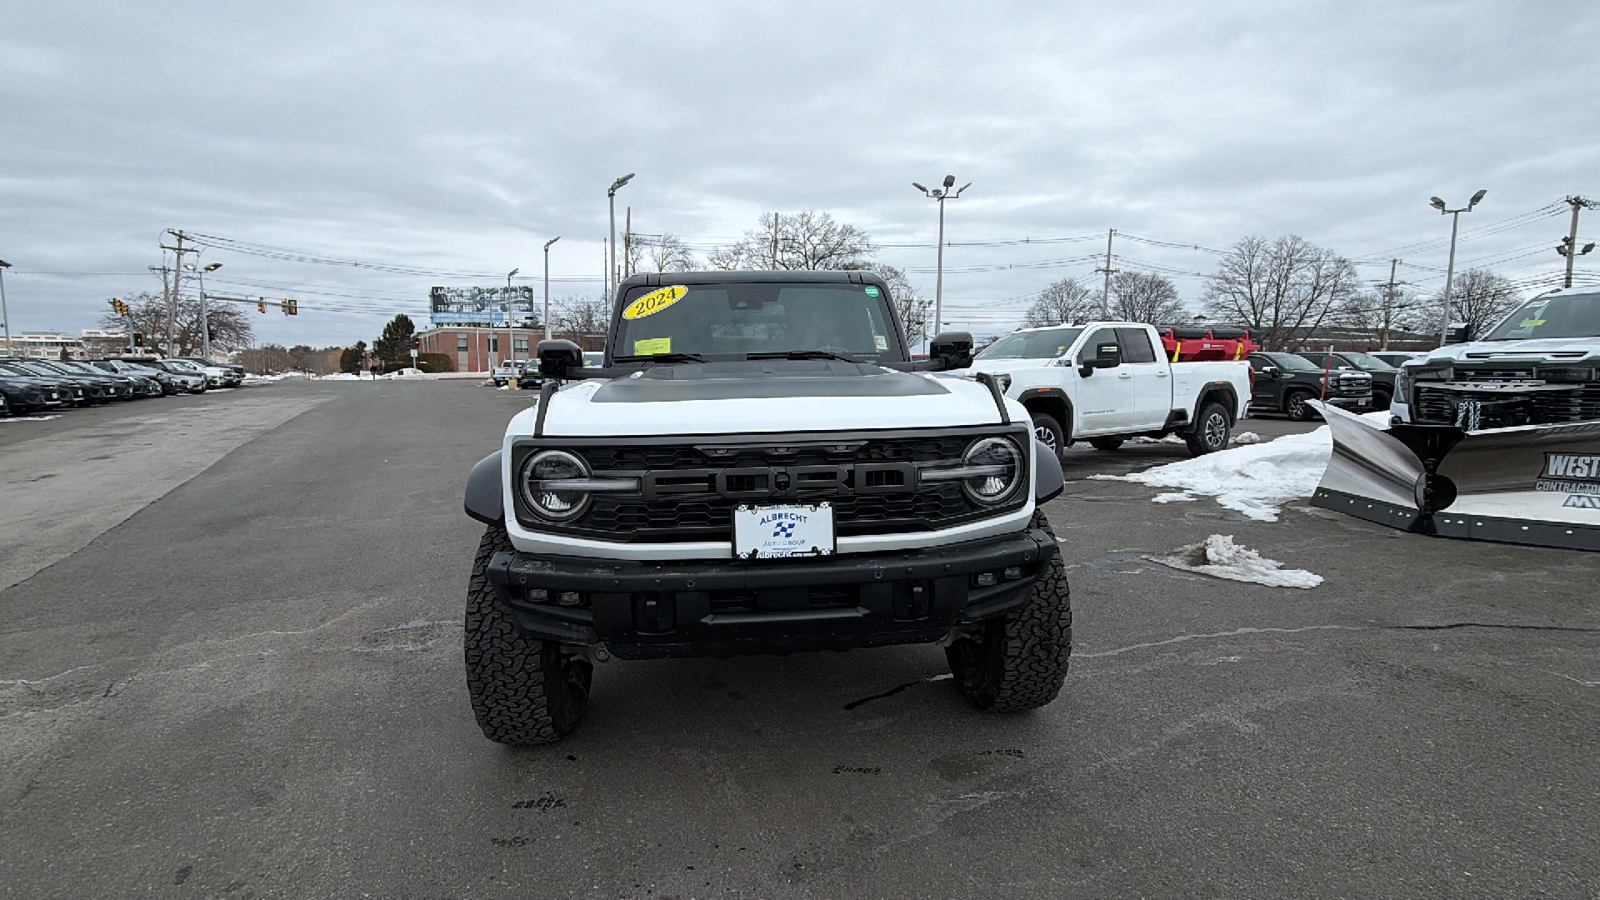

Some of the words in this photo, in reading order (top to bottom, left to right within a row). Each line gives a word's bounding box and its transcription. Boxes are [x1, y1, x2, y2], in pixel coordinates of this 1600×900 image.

[635, 288, 677, 315] 2024
[1548, 454, 1600, 478] WEST
[643, 461, 916, 499] FORD
[759, 512, 808, 526] ALBRECHT
[756, 551, 793, 559] Albrecht
